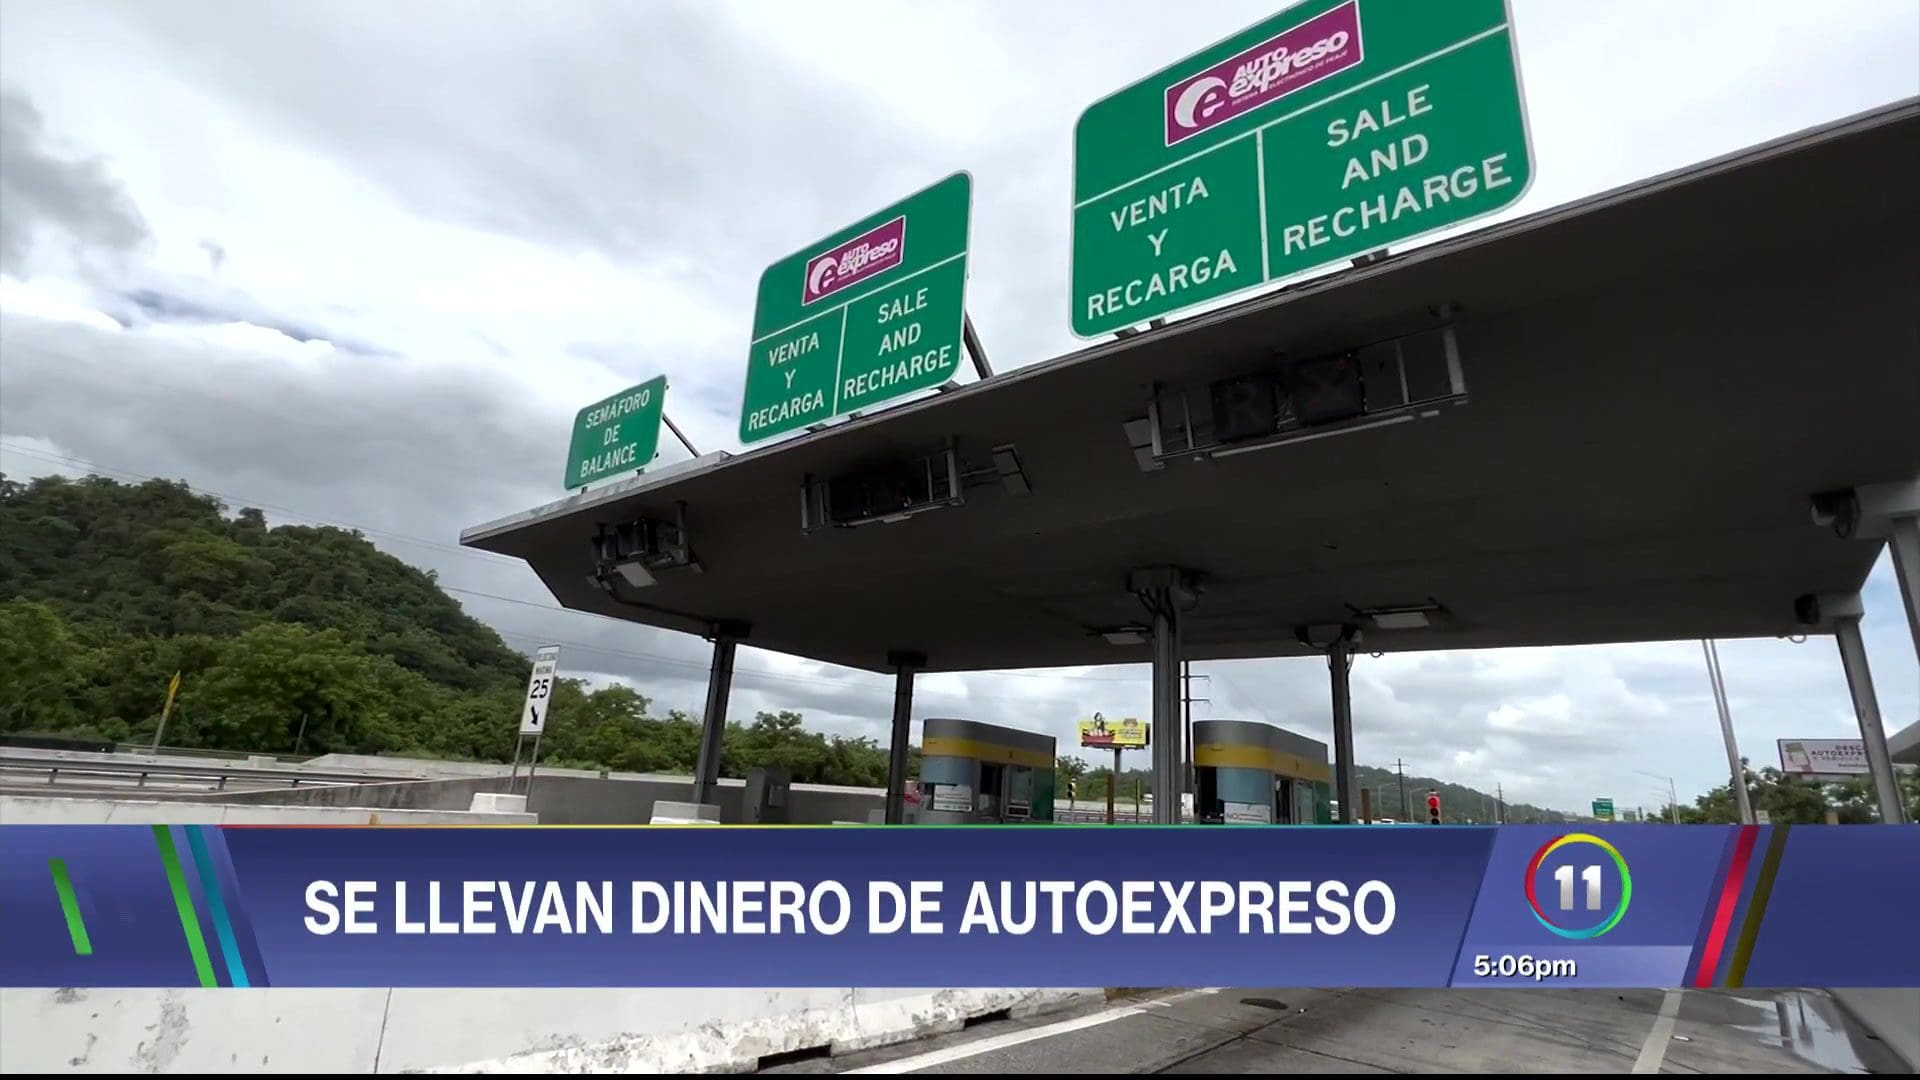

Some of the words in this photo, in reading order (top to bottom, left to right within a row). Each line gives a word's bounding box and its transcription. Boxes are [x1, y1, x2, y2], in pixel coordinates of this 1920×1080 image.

[1229, 31, 1349, 98] expreso
[1232, 47, 1288, 82] AUTO
[1326, 84, 1433, 148] SALE
[1341, 133, 1430, 190] AND
[1110, 176, 1209, 232] VENTA
[1283, 153, 1512, 256] RECHARGE
[837, 238, 898, 275] expreso
[841, 243, 869, 262] AUTO
[1147, 229, 1168, 258] Y
[1087, 249, 1238, 320] RECARGA
[877, 287, 928, 324] SALE
[768, 332, 820, 367] VENTA
[878, 322, 921, 356] AND
[785, 368, 796, 389] Y
[843, 345, 952, 400] RECHARGE
[585, 388, 650, 429] SEMÁFORO
[748, 389, 824, 431] RECARGA
[604, 424, 621, 445] DE
[580, 442, 638, 478] BALANCE
[530, 679, 549, 699] 25
